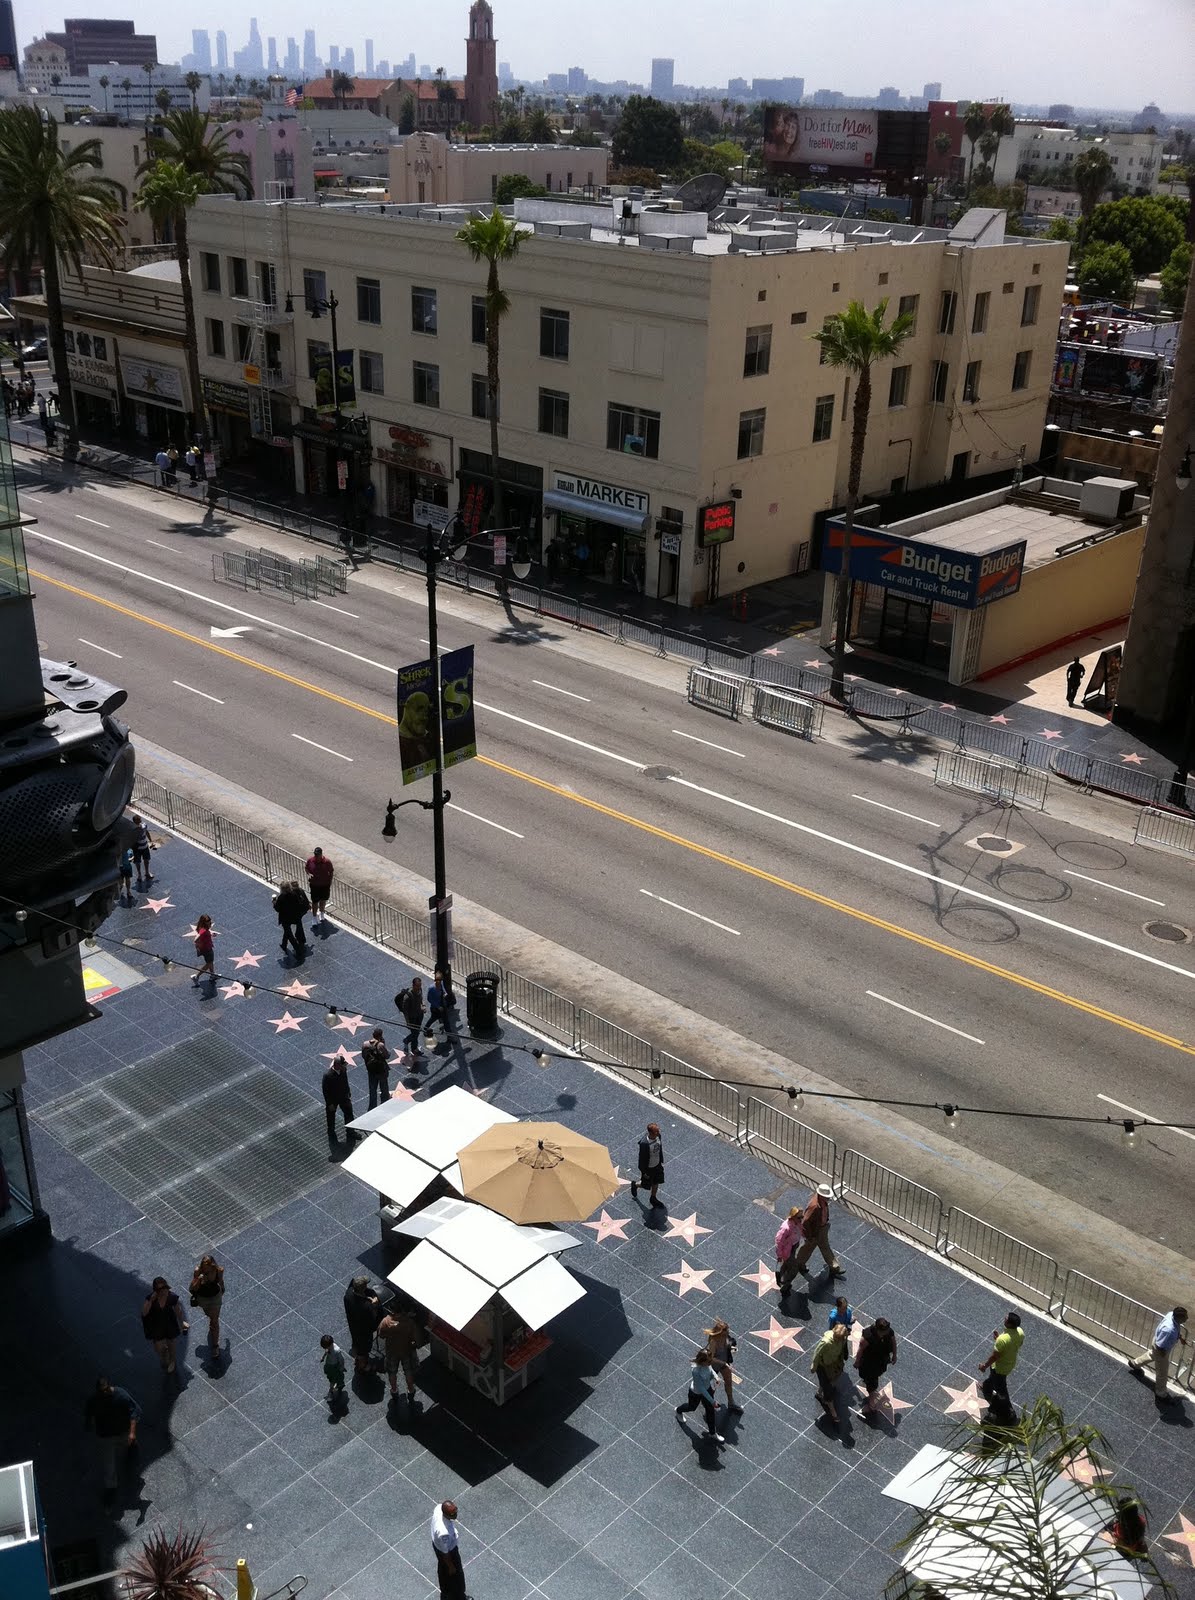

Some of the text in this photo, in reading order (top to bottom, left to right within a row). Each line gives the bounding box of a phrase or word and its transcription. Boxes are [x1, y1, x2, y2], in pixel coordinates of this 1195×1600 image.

[804, 117, 873, 135] Do it for Mom
[577, 480, 647, 510] MARKET
[705, 505, 731, 518] Public
[704, 517, 733, 531] Parking
[901, 545, 973, 583] Budget
[980, 547, 1022, 577] Budget
[881, 569, 969, 601] Car and Truck Rental
[399, 666, 432, 685] SHREK
